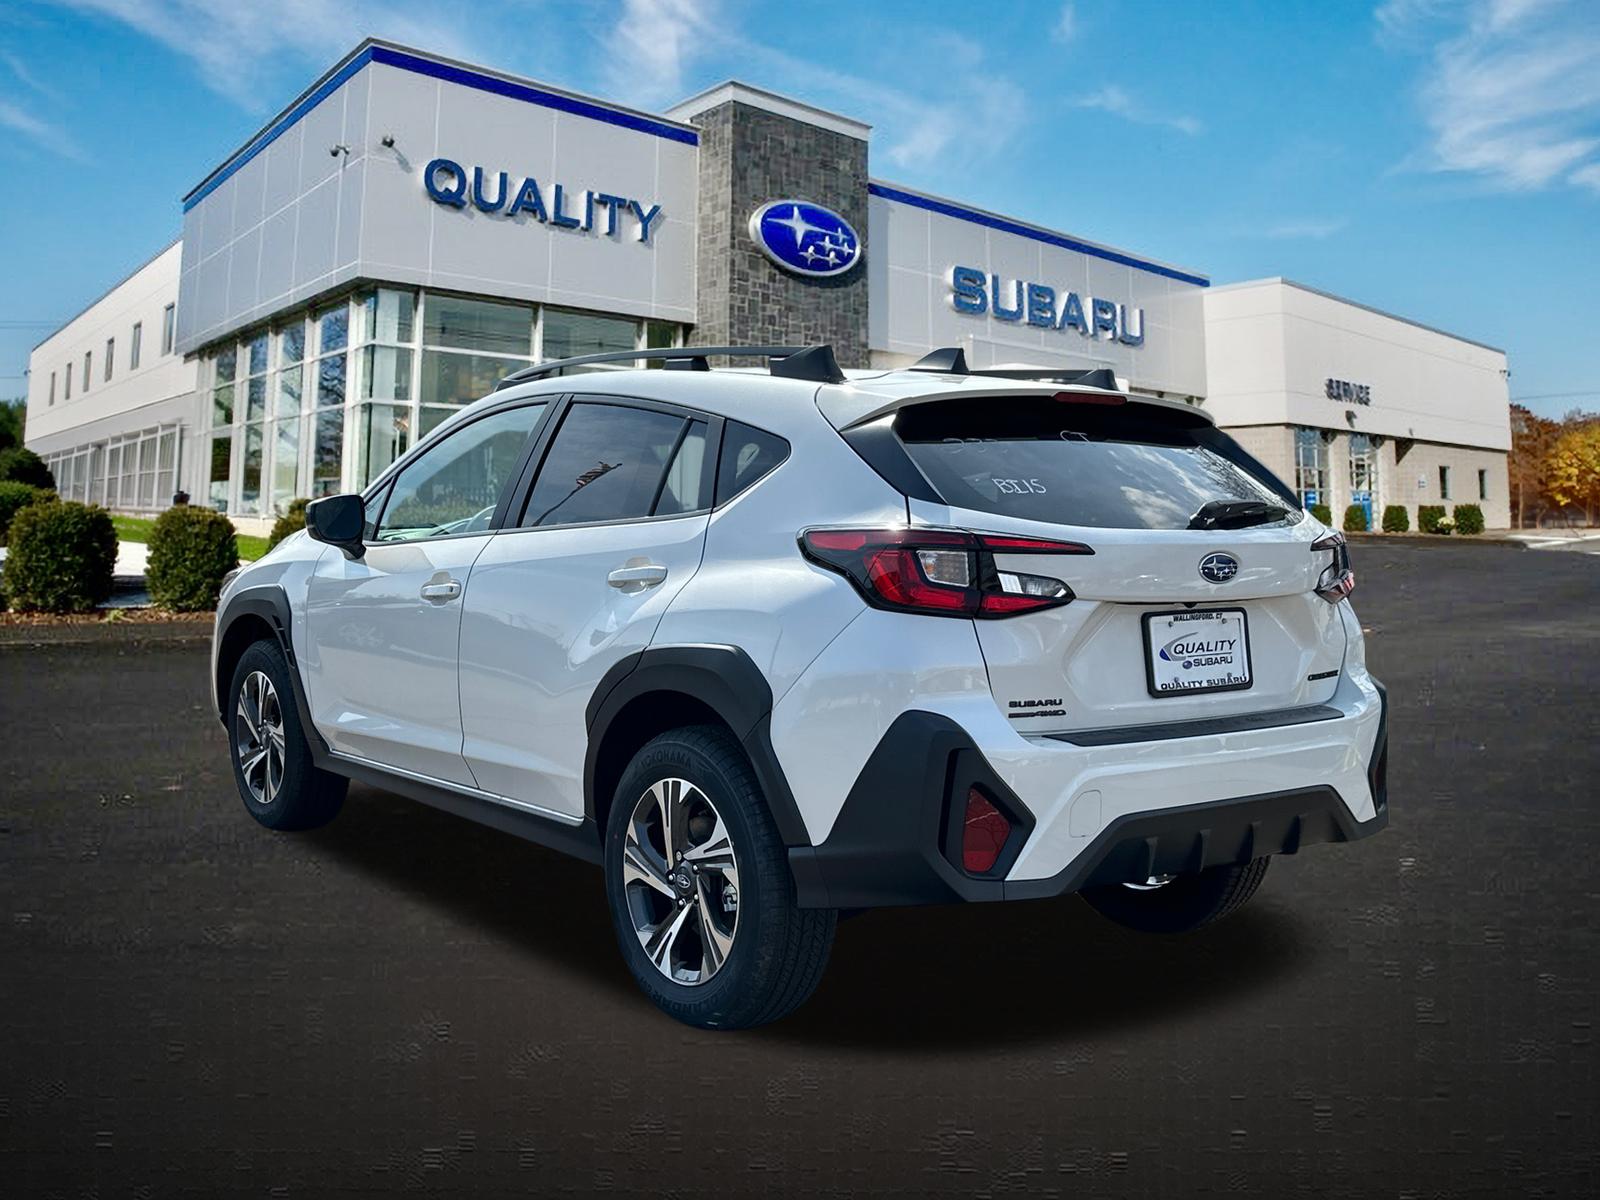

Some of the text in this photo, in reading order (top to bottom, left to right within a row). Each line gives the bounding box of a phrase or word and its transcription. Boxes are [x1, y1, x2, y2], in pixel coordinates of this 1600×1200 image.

[424, 157, 663, 243] QUALITY
[950, 265, 1145, 347] SUBARU
[1325, 378, 1371, 407] SERVICE
[1173, 639, 1237, 655] QUALITY
[1193, 656, 1233, 667] SUBARU
[1161, 675, 1247, 690] QUALITY SUBARU
[1008, 698, 1063, 708] SUBARU
